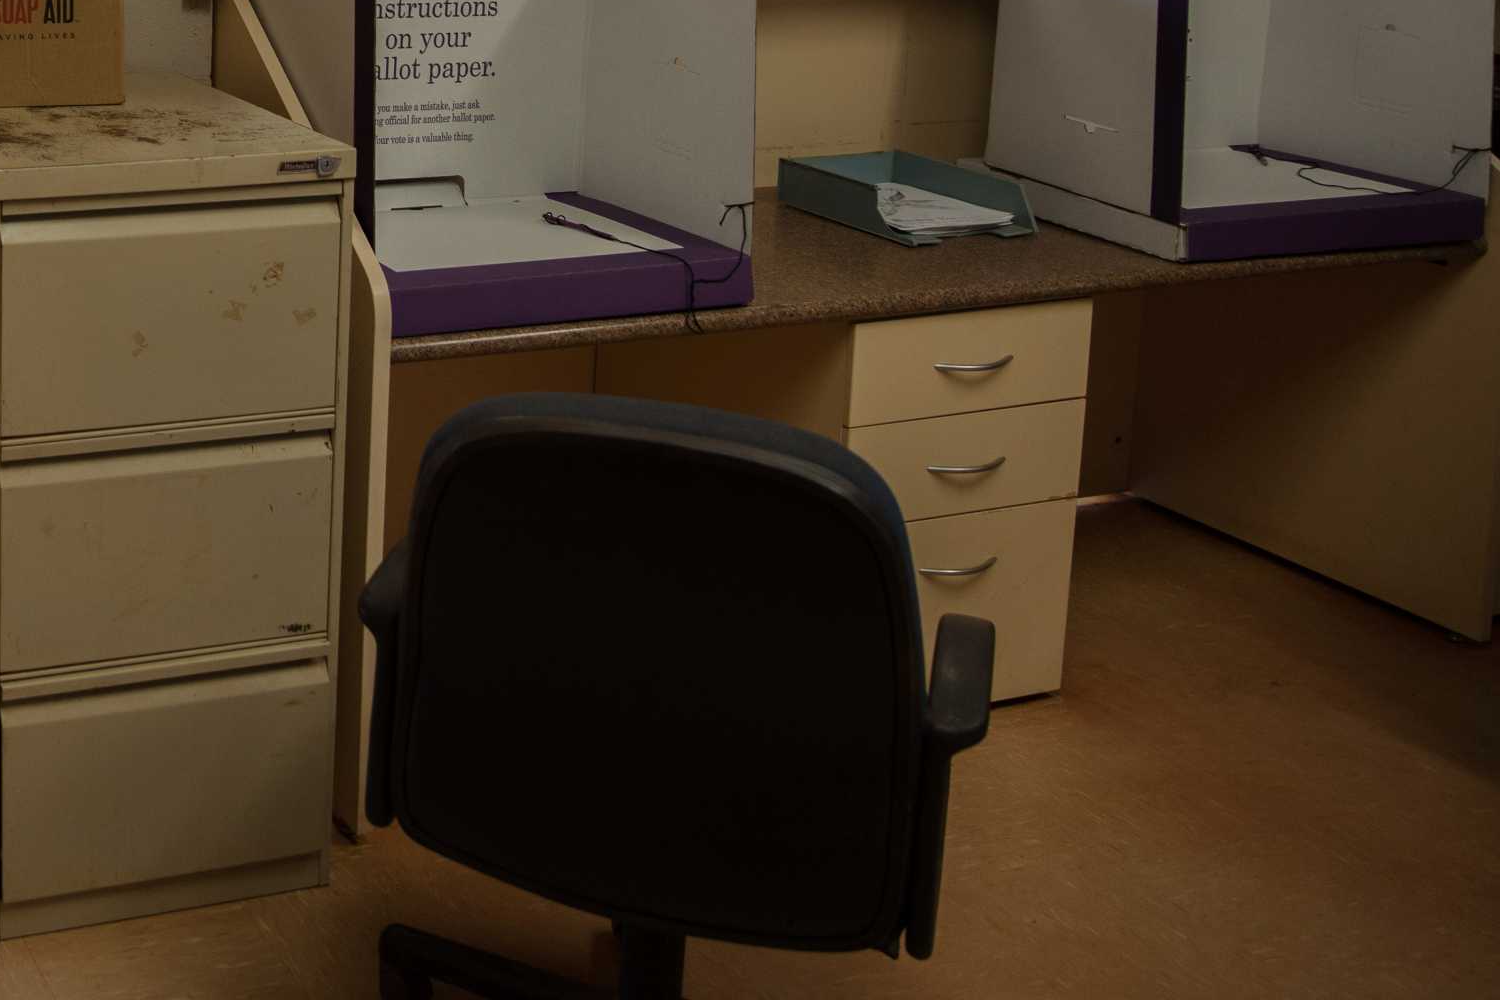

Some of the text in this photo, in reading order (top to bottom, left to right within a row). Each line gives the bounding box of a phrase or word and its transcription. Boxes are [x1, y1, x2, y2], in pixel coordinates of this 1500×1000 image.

[41, 32, 76, 40] LIVES
[385, 31, 472, 54] on your
[374, 56, 496, 85] allot paper.
[377, 105, 391, 114] you
[392, 101, 412, 112] make
[420, 100, 451, 111] mistake,
[452, 100, 466, 111] just
[467, 99, 480, 109] ask
[385, 115, 410, 126] official
[411, 115, 422, 125] for
[423, 114, 451, 124] another
[452, 112, 472, 122] ballot
[473, 113, 496, 123] paper.
[390, 135, 407, 144] vote
[422, 131, 452, 143] valuable
